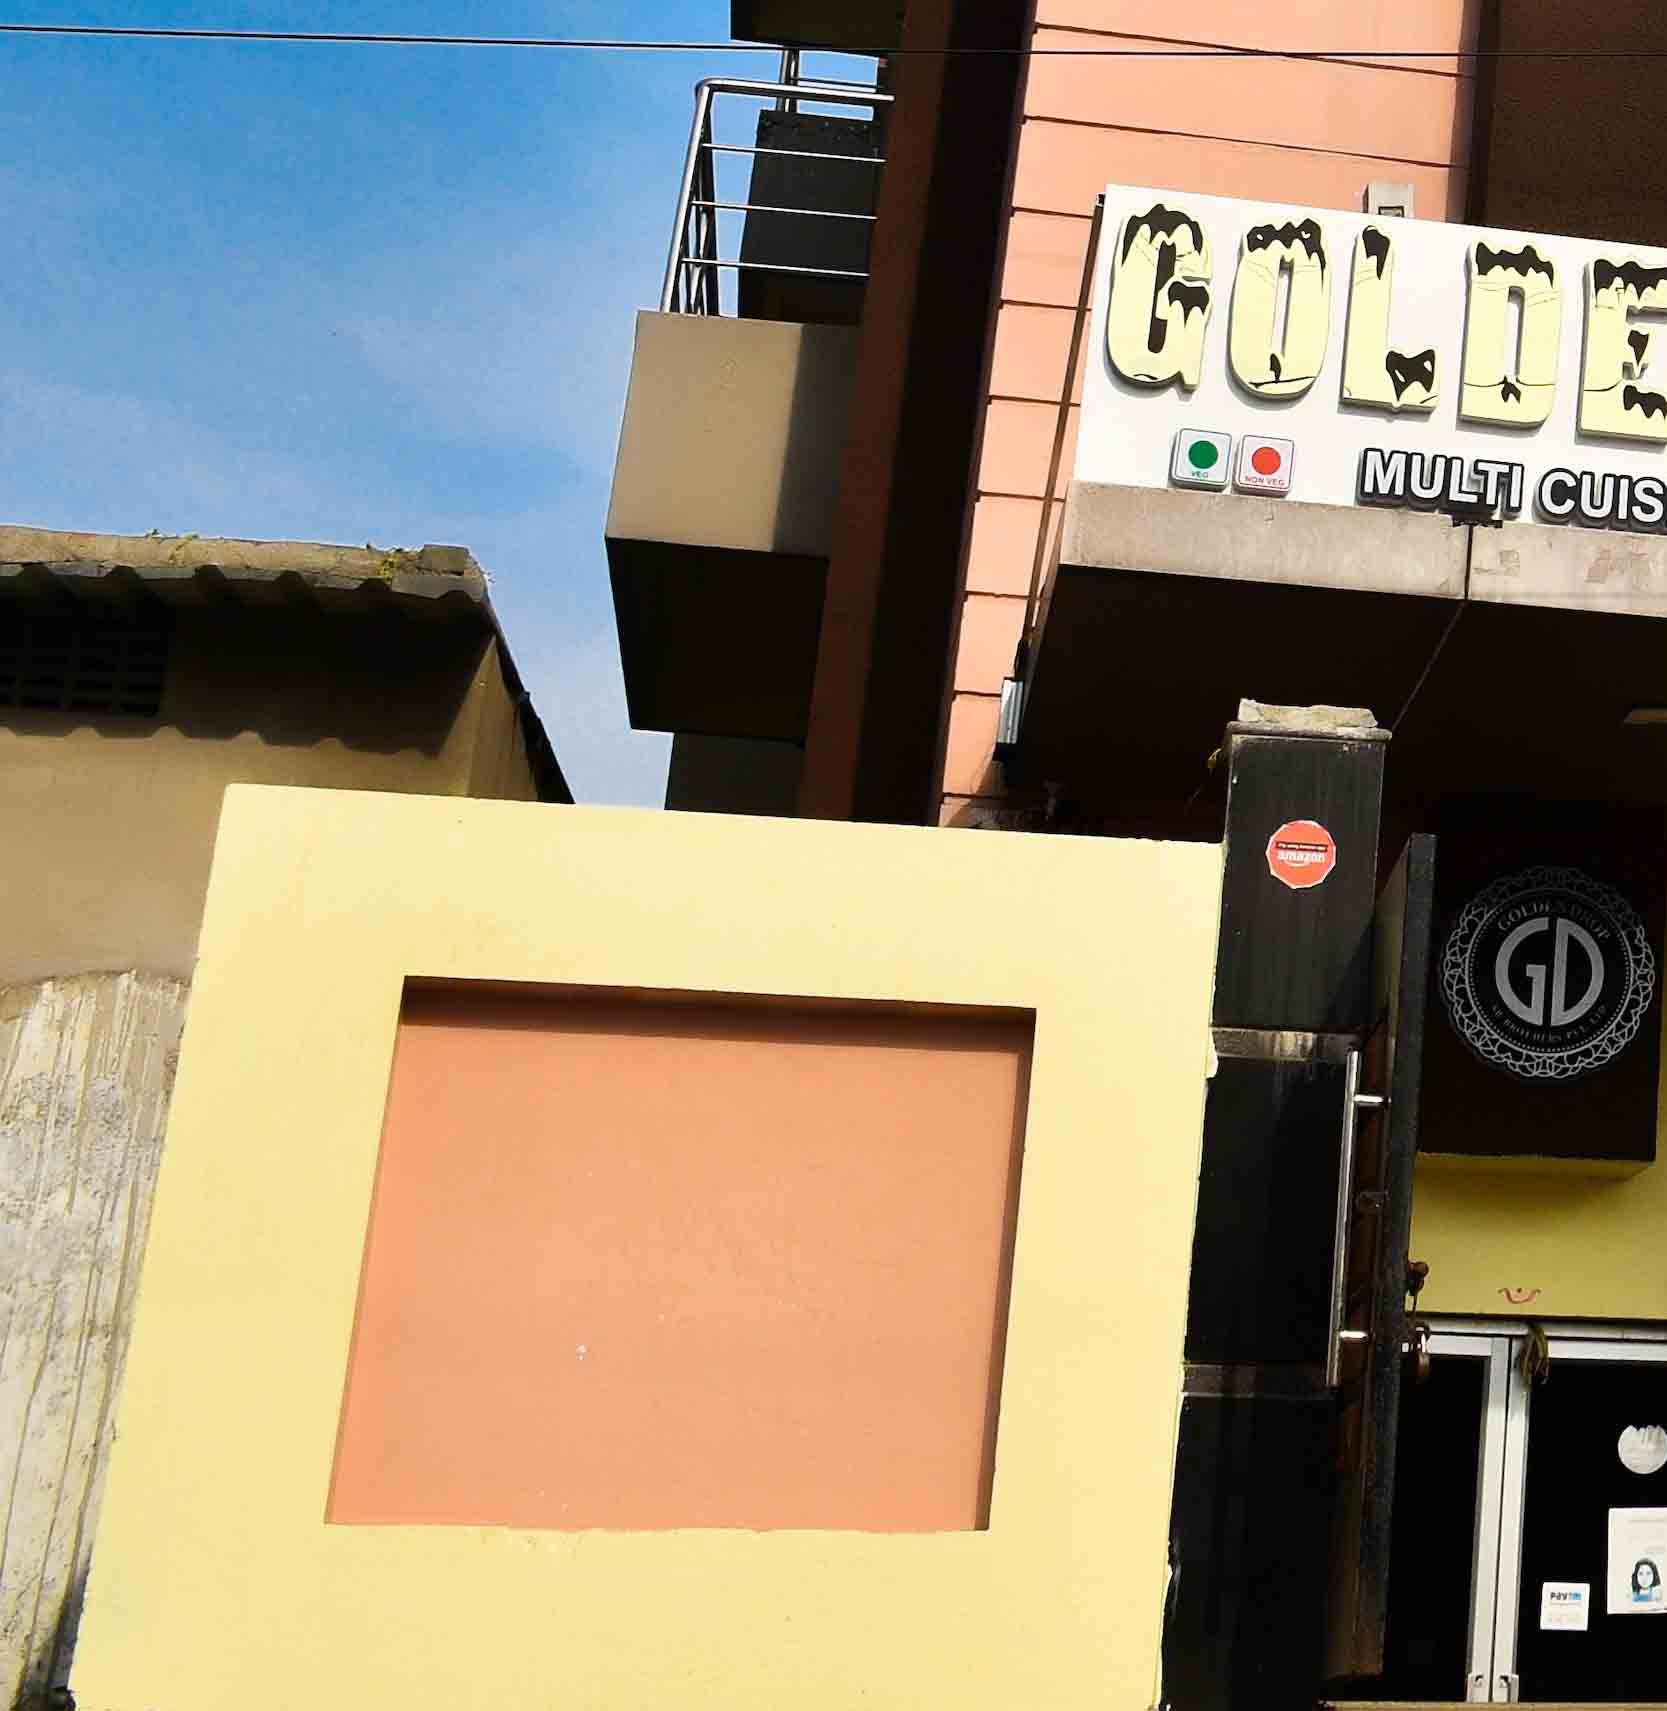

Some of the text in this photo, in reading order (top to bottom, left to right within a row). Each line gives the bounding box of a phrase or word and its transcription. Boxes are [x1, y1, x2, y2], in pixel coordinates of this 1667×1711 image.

[1245, 475, 1285, 486] NON VEG
[1360, 447, 1526, 514] MULTI
[1278, 850, 1325, 864] amazon
[1495, 917, 1604, 1027] GD
